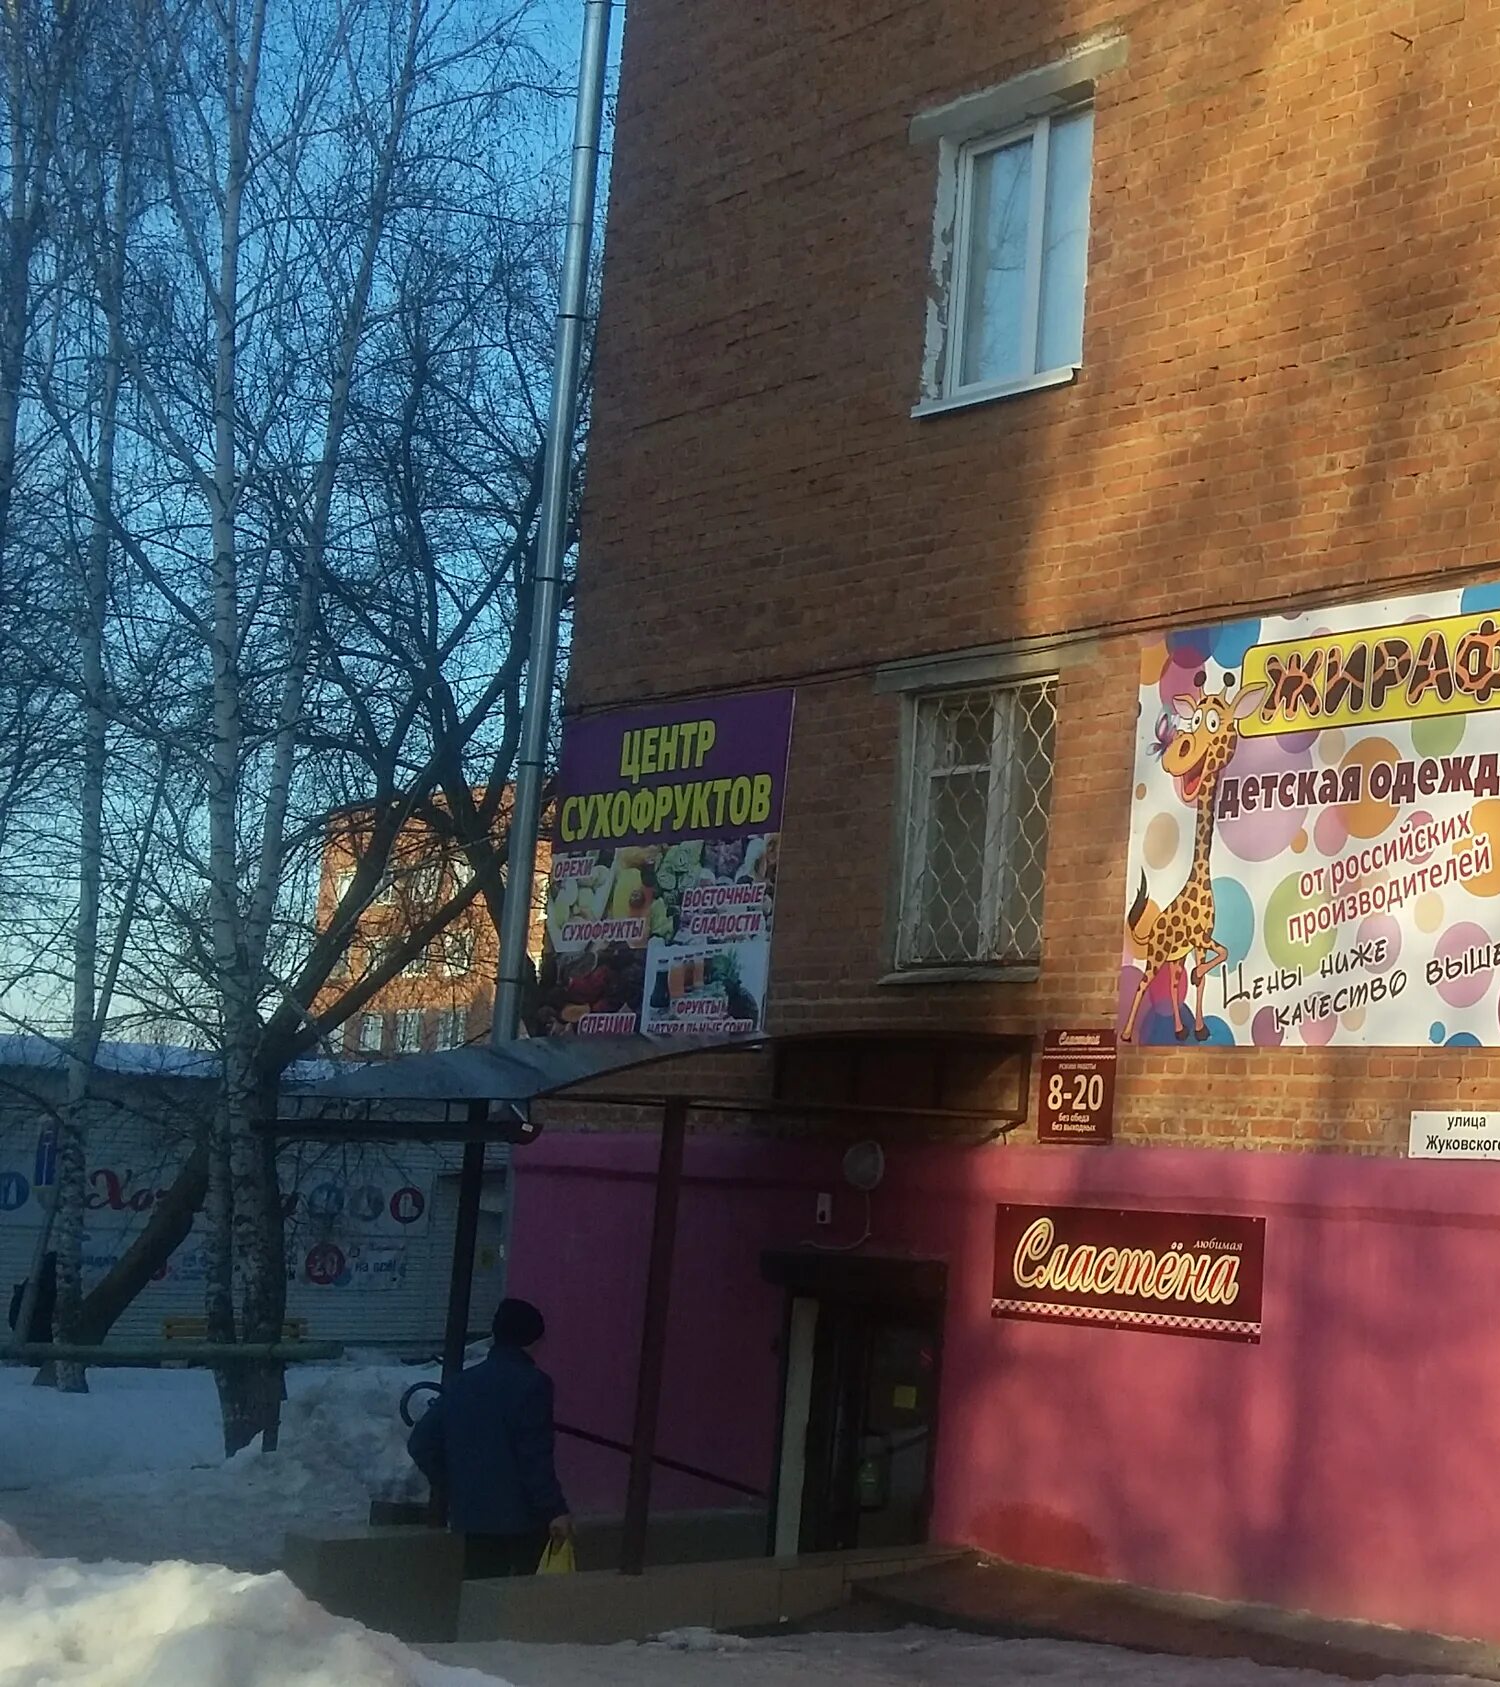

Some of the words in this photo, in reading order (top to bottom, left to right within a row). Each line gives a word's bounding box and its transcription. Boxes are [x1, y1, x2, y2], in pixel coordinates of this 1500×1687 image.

[620, 719, 717, 784] ЦЕНТР
[1218, 765, 1364, 819] детская
[561, 774, 772, 842] СУХОФРУКТОВ
[554, 857, 594, 879] ОРЕХИ
[1300, 869, 1325, 897] от
[1332, 811, 1471, 884] российских
[682, 887, 765, 907] ВОСТОЧНЫЕ
[1288, 841, 1491, 942] производителей
[561, 921, 645, 941] СУХОФРУКТЫ
[690, 914, 761, 936] СЛАДОСТИ
[676, 1001, 722, 1015] ФРУКТЫ
[1047, 1074, 1104, 1111] 8-20
[1447, 1116, 1486, 1130] улица
[1193, 1236, 1243, 1252] любимая
[1013, 1217, 1240, 1305] Сластёна
